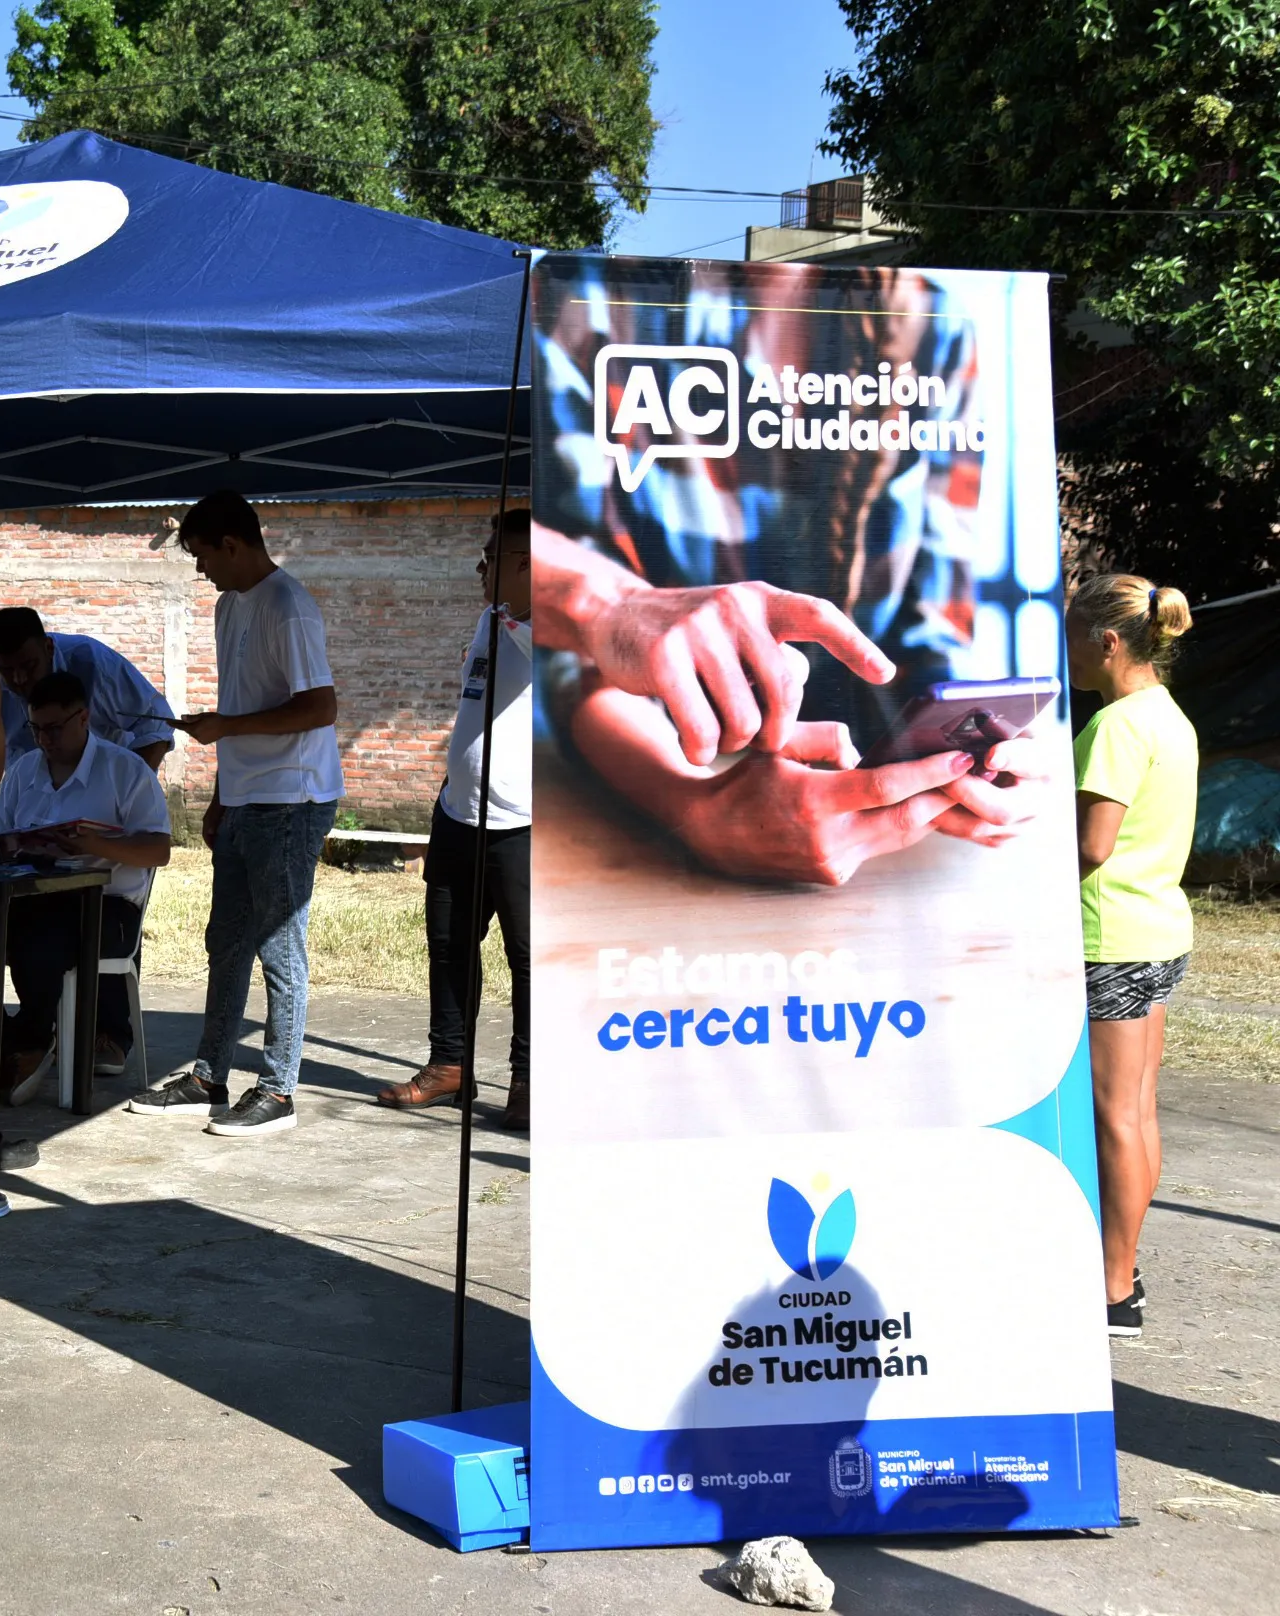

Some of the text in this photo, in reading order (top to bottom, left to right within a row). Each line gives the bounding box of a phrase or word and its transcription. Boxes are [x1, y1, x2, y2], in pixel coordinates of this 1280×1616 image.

[611, 365, 726, 436] AC
[747, 361, 946, 408] Atención
[747, 406, 988, 452] Ciudadana
[597, 946, 860, 998] Estamos
[597, 996, 926, 1058] cerca tuyo
[778, 1290, 852, 1309] CIUDAD
[721, 1311, 912, 1354] San Miguel
[708, 1345, 928, 1387] de Tucumán
[878, 1450, 920, 1458] MUNICIPIO
[879, 1458, 955, 1475] San Miguel
[985, 1461, 1049, 1473] Atención al
[700, 1469, 792, 1491] smt.gob.ar
[880, 1472, 967, 1488] de Tucumán
[985, 1472, 1049, 1483] Ciudadano
